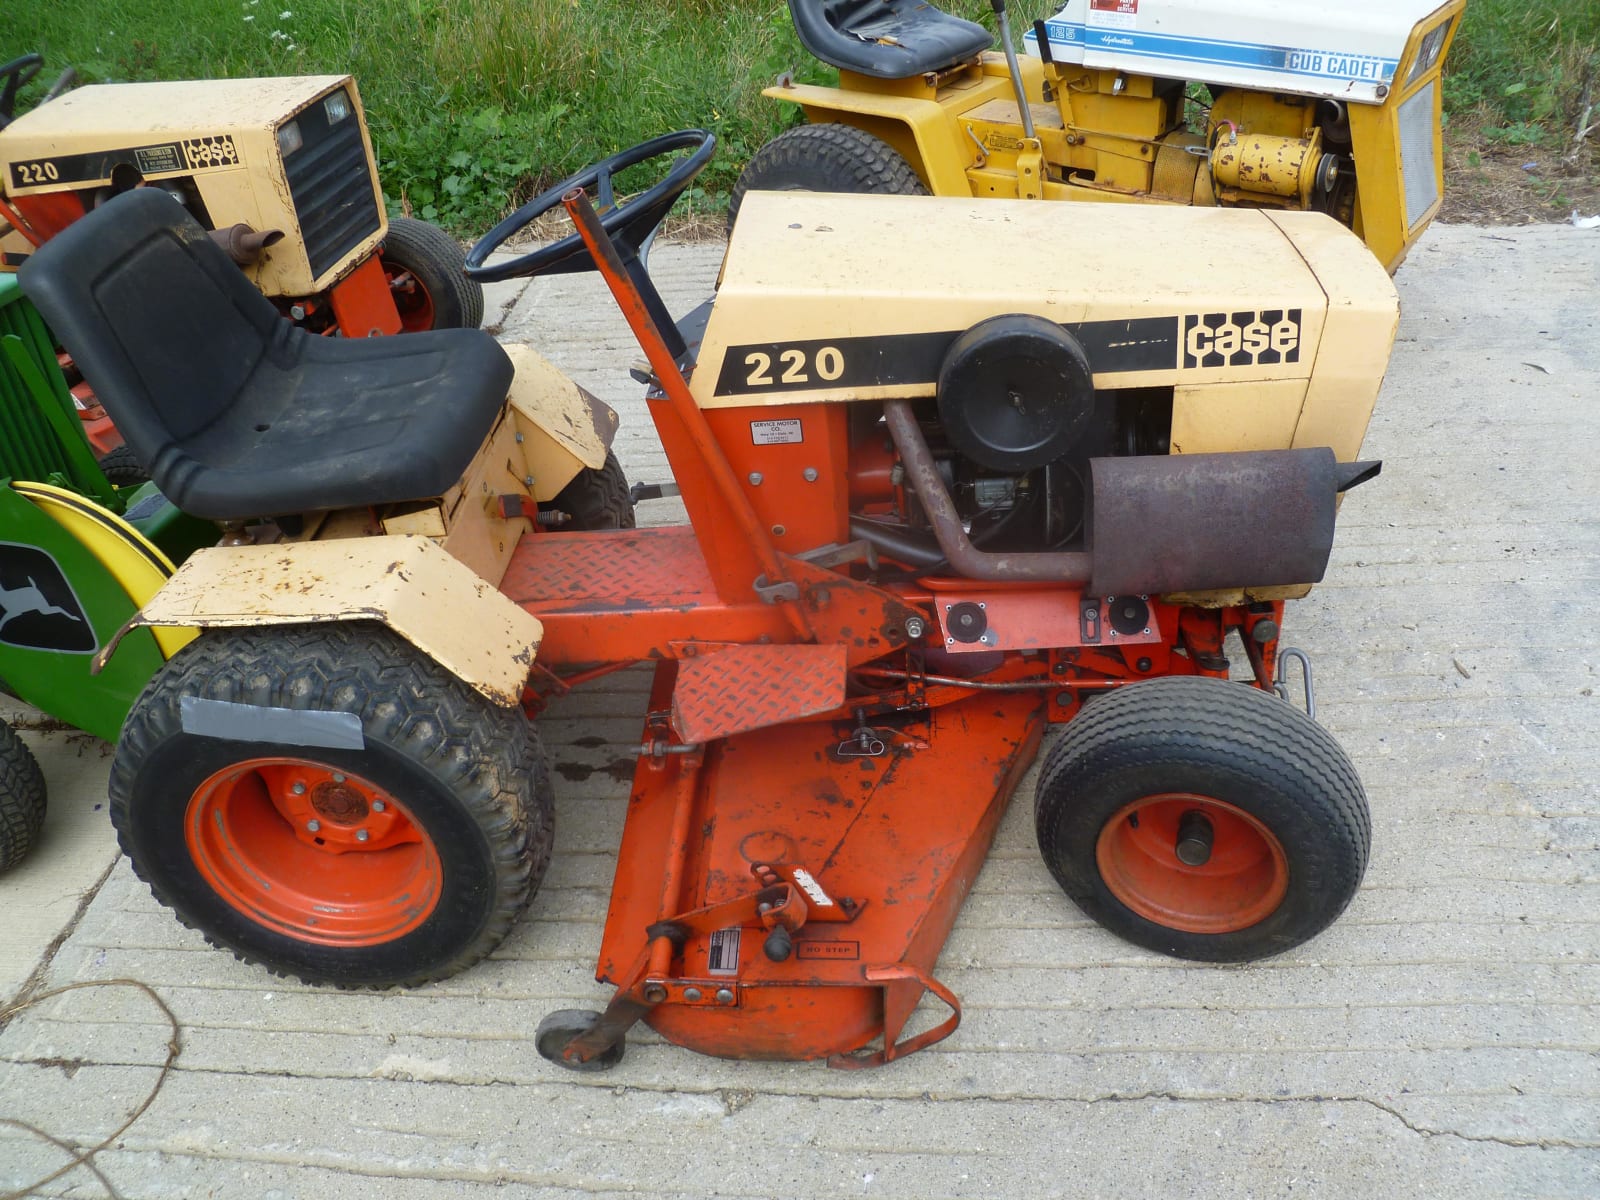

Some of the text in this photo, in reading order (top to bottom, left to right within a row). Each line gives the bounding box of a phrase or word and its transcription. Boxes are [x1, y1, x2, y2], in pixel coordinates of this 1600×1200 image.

[1050, 25, 1075, 40] 125
[1289, 52, 1323, 72] CUB
[1326, 57, 1380, 79] CADET
[17, 161, 59, 183] 220
[1186, 315, 1299, 361] case
[744, 346, 846, 386] 220
